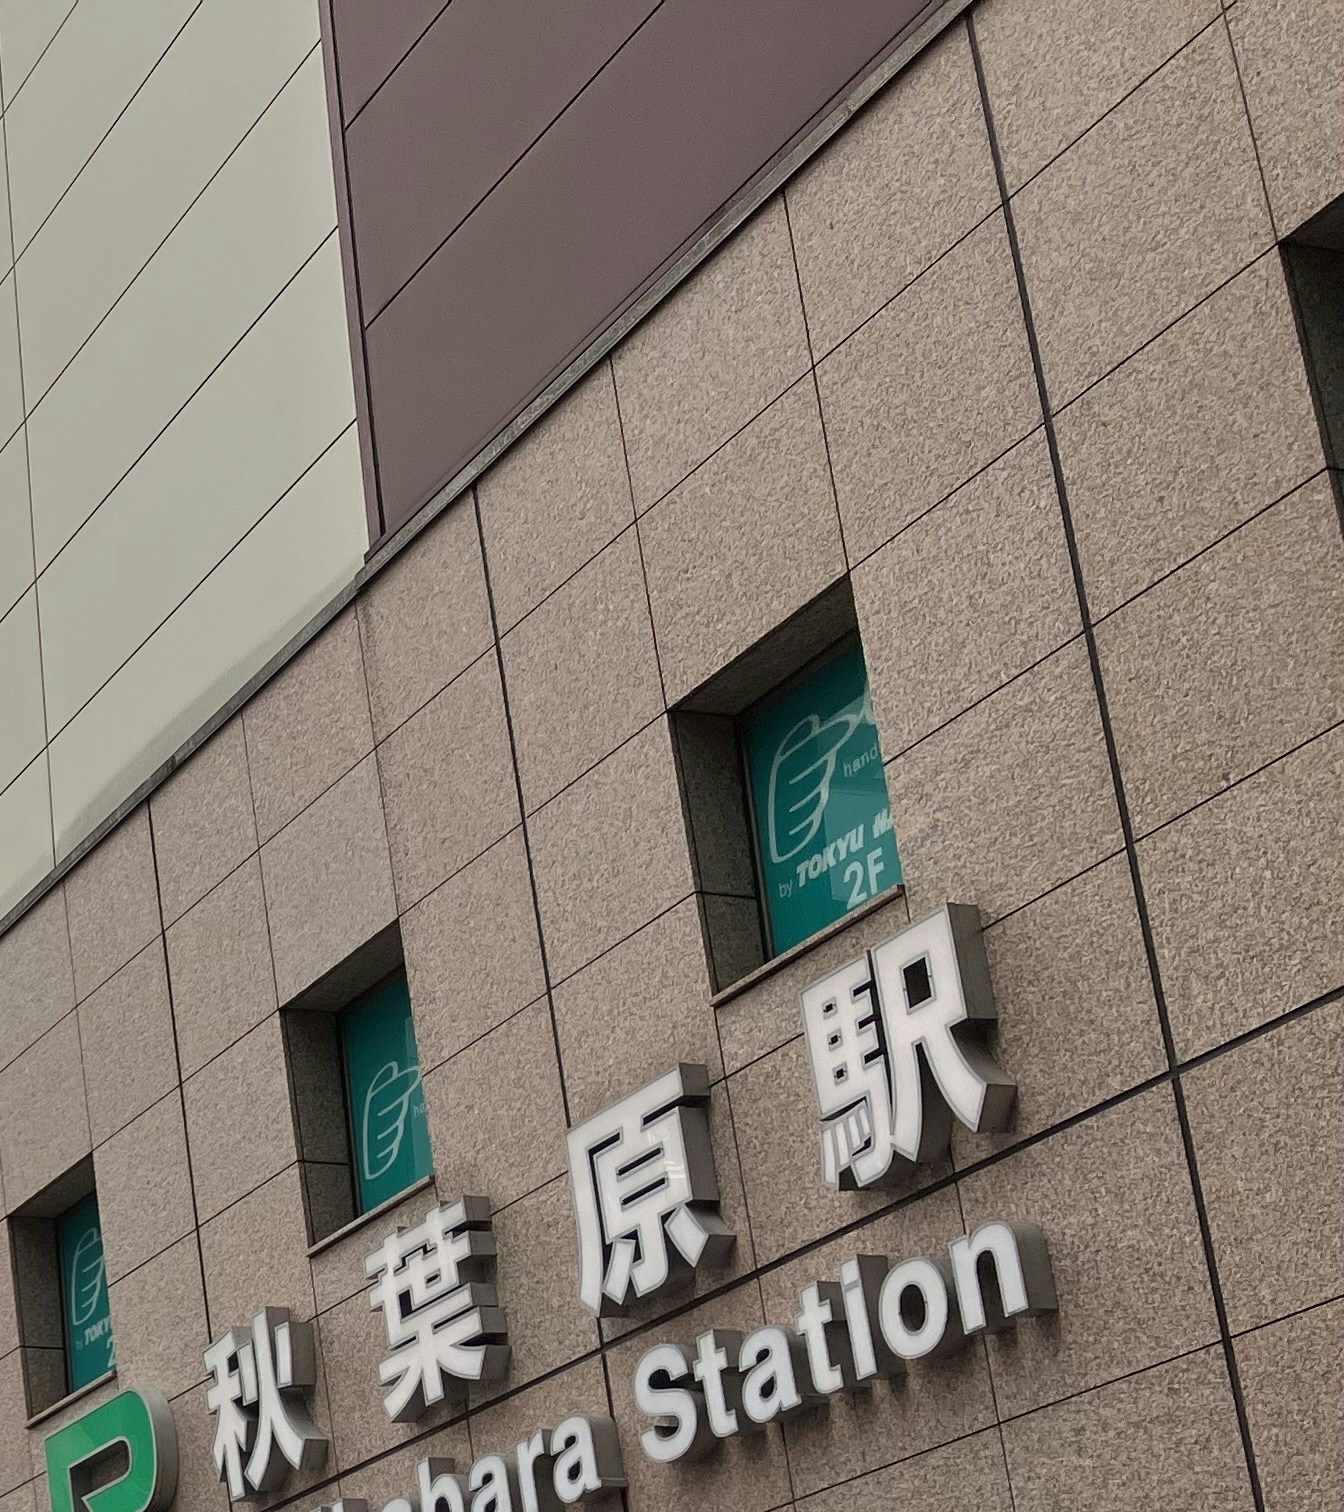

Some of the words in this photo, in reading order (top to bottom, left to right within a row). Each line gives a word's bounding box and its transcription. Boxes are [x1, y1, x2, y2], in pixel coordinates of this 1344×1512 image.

[778, 880, 794, 899] by
[796, 823, 865, 888] TOKYU
[842, 849, 886, 912] 2F
[202, 903, 992, 1504] 秋葉原駅
[632, 1220, 1034, 1466] Station
